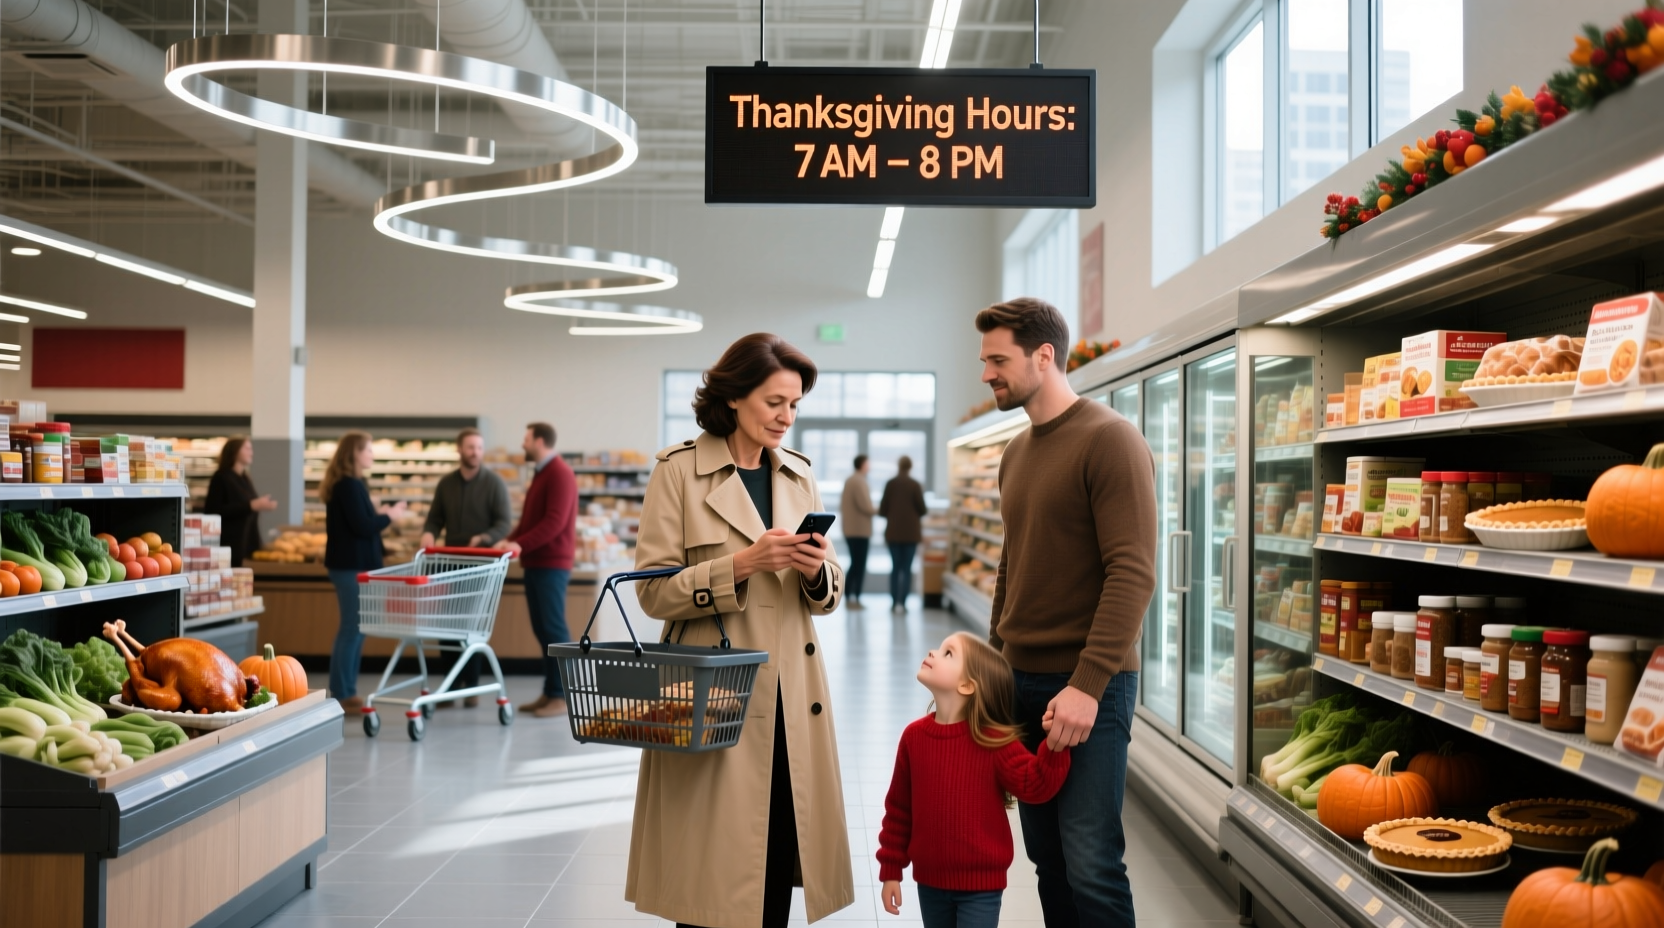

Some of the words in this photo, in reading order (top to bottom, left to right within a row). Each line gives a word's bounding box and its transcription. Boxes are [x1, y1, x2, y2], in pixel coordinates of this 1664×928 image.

[729, 95, 954, 138] Thanksgiving
[967, 97, 1075, 130] Hours:
[794, 144, 815, 178] 7
[820, 144, 876, 178] AM
[919, 144, 941, 179] 8
[951, 145, 1003, 179] PM
